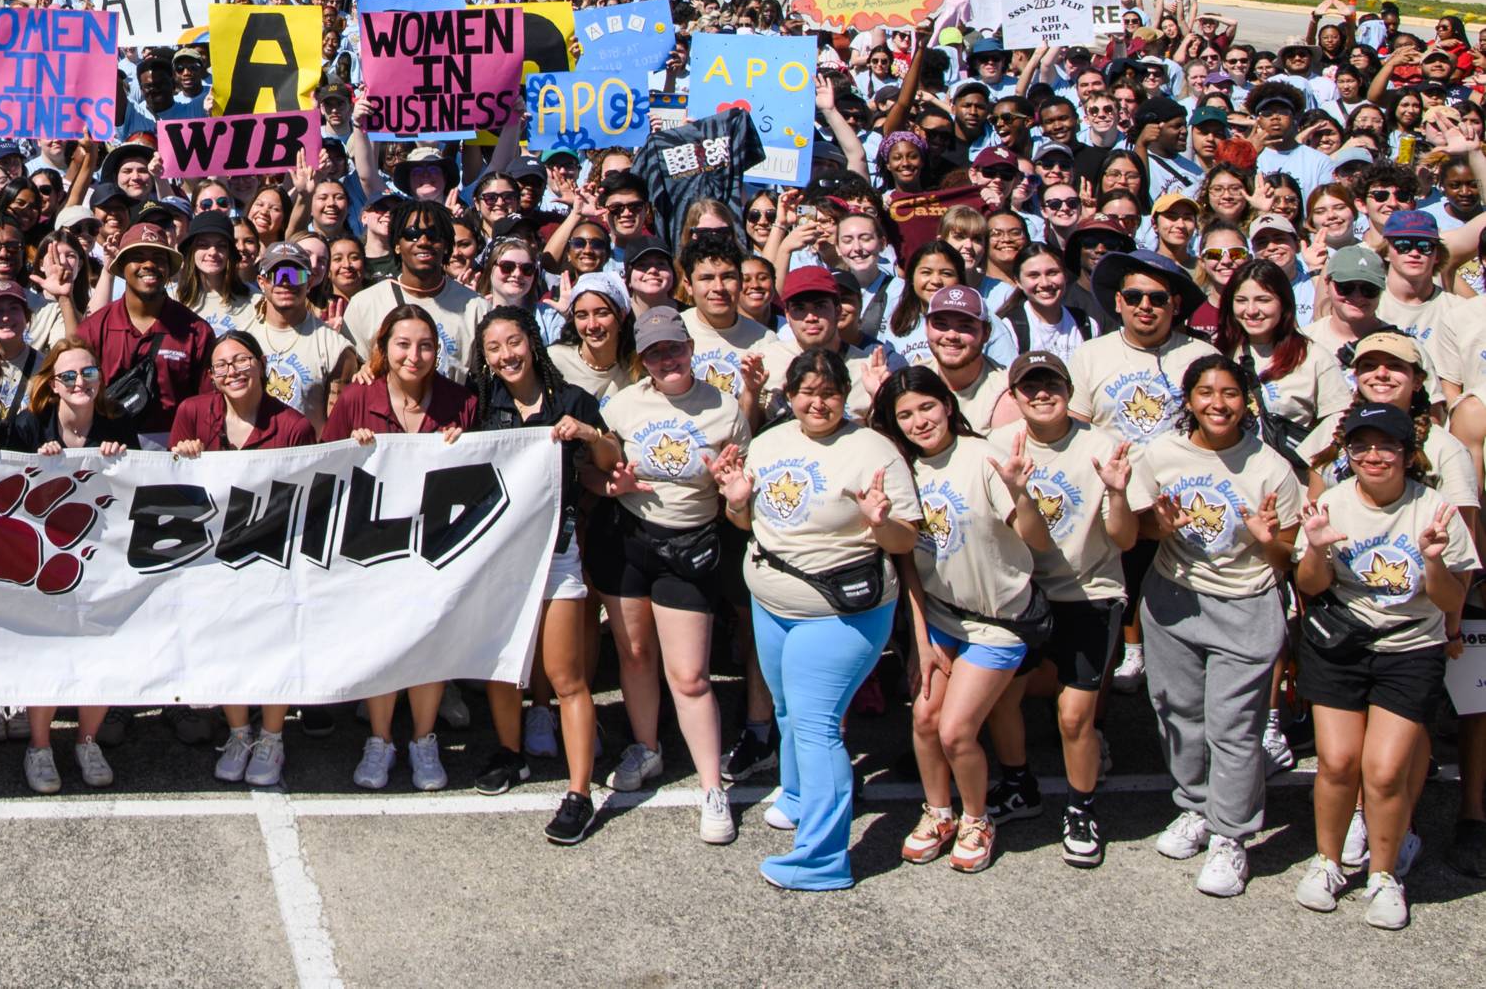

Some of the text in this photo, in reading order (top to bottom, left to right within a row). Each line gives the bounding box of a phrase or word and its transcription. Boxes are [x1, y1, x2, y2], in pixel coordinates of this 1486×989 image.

[1041, 15, 1060, 24] PHI
[1061, 0, 1085, 11] FLIP
[363, 9, 514, 58] WOMEN
[1031, 23, 1070, 33] KAPPA
[1042, 33, 1061, 41] PHI
[4, 51, 67, 95] IN
[224, 12, 302, 115] A
[413, 55, 473, 94] IN
[703, 55, 810, 93] APO
[367, 90, 513, 133] BUSINESS
[538, 77, 634, 136] APO
[165, 116, 309, 174] WIB
[285, 354, 314, 385] Build
[1105, 369, 1153, 399] Bobcat
[633, 418, 677, 444] Bobcat
[758, 457, 828, 494] Bobcat Build
[1051, 469, 1085, 507] Build
[1163, 473, 1213, 503] Bobcat
[939, 481, 970, 514] Build
[127, 462, 510, 574] BUILD
[1338, 532, 1390, 567] Bobcat
